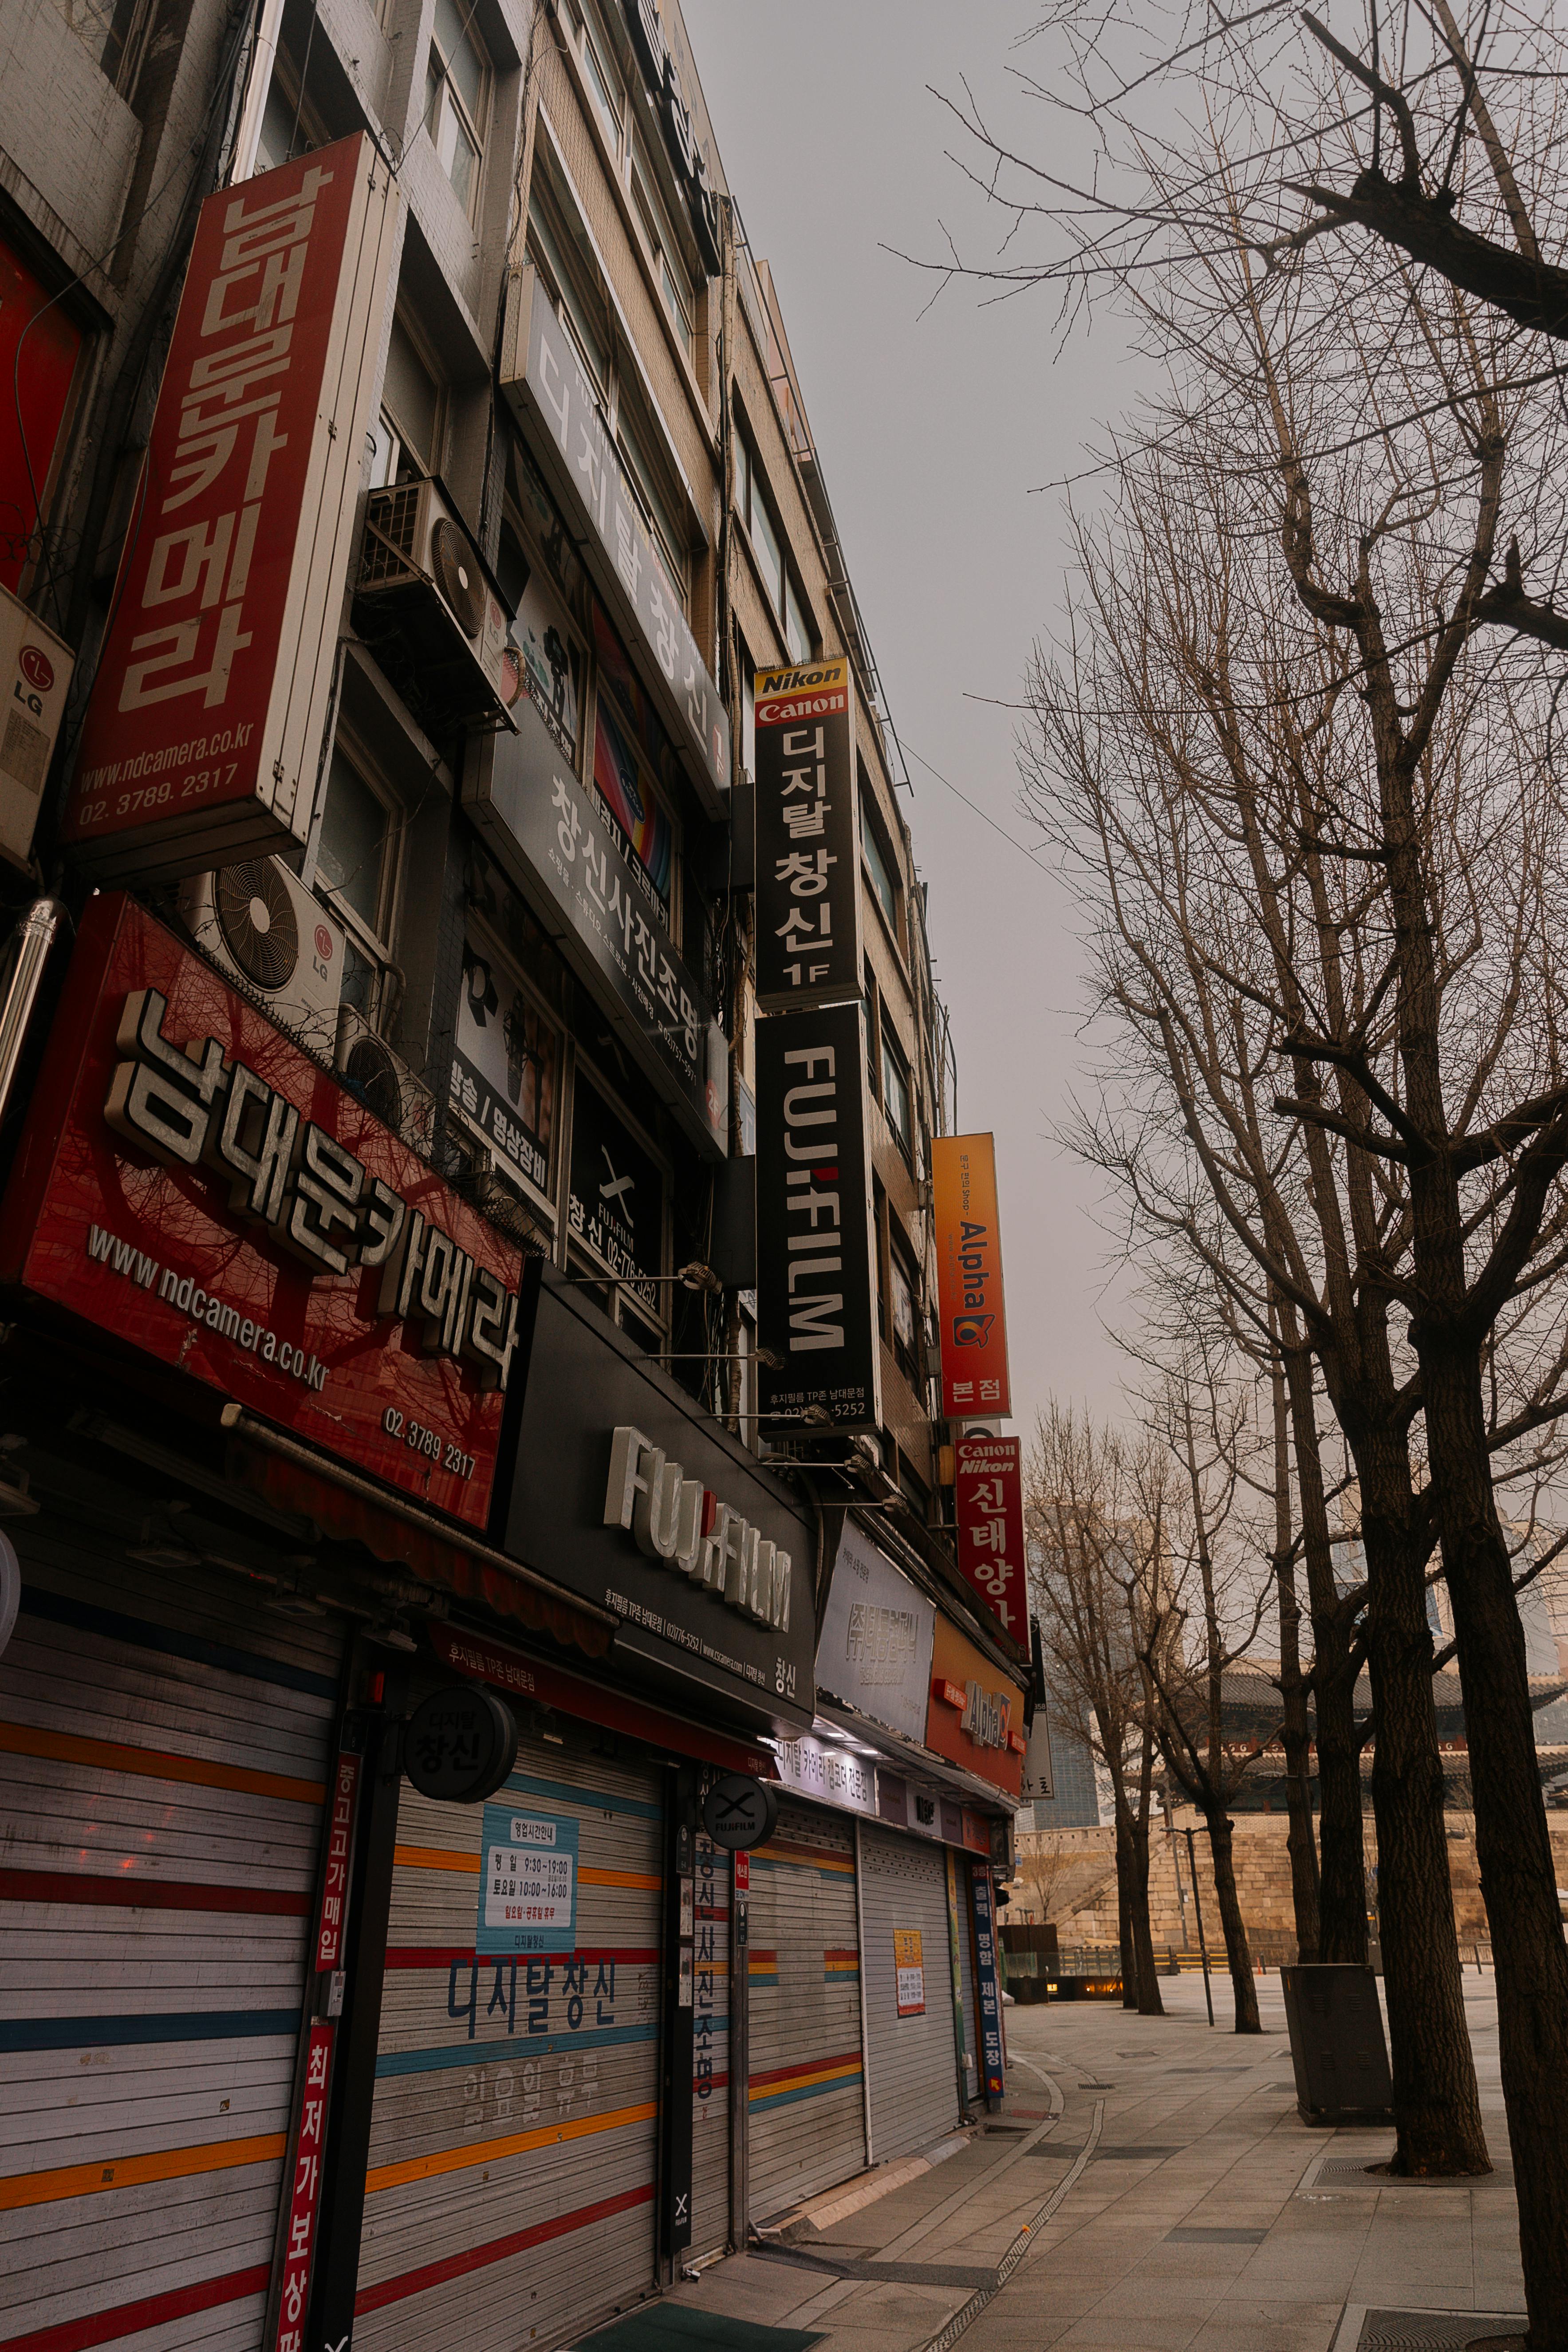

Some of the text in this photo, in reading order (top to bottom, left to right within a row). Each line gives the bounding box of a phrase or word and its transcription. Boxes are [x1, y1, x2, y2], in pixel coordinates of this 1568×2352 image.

[118, 165, 336, 713] 남대문카메라
[489, 625, 498, 645] LG
[763, 667, 840, 693] Nikon
[14, 680, 43, 717] LG
[759, 693, 844, 722] Canon
[80, 722, 254, 794] www.ndcamera.co.kr
[181, 763, 238, 797] 2317
[312, 955, 327, 982] LG
[783, 964, 830, 985] 1F
[494, 1107, 545, 1188] 영상장비
[105, 988, 520, 1393] 남대문카메라
[784, 1046, 845, 1351] FUJIFILM
[599, 1202, 634, 1253] FUJIFILM
[957, 1220, 991, 1309] Alpha
[770, 1387, 864, 1405] 후지필름 TP존 남대문점
[406, 1421, 441, 1460] 3789
[442, 1444, 476, 1480] 2317
[958, 1444, 1015, 1458] Canon
[960, 1460, 1014, 1474] Nikon
[604, 1426, 792, 1633] FUJIFILM
[604, 1588, 662, 1634] 후지필름 TP존 남대문점
[666, 1622, 699, 1651] 02)776-5252
[449, 1642, 535, 1692] 후지필름 TP존 남대문점
[703, 1643, 743, 1673] www.cscamera.com
[775, 1656, 796, 1699] 창신
[429, 1711, 477, 1730] 디지탈
[415, 1733, 480, 1773] 창신
[778, 1741, 867, 1802] 디지탈 카메라 캠코더 전문점
[515, 1822, 553, 1841] 영업시간안내
[716, 1822, 755, 1832] FUJIFILM
[524, 1857, 567, 1875] 9:30~19:00
[493, 1879, 567, 1898] 토요일 10:00~16:00
[544, 1907, 555, 1920] 휴무
[975, 1886, 1000, 2066] 출력 명함 제본 도장
